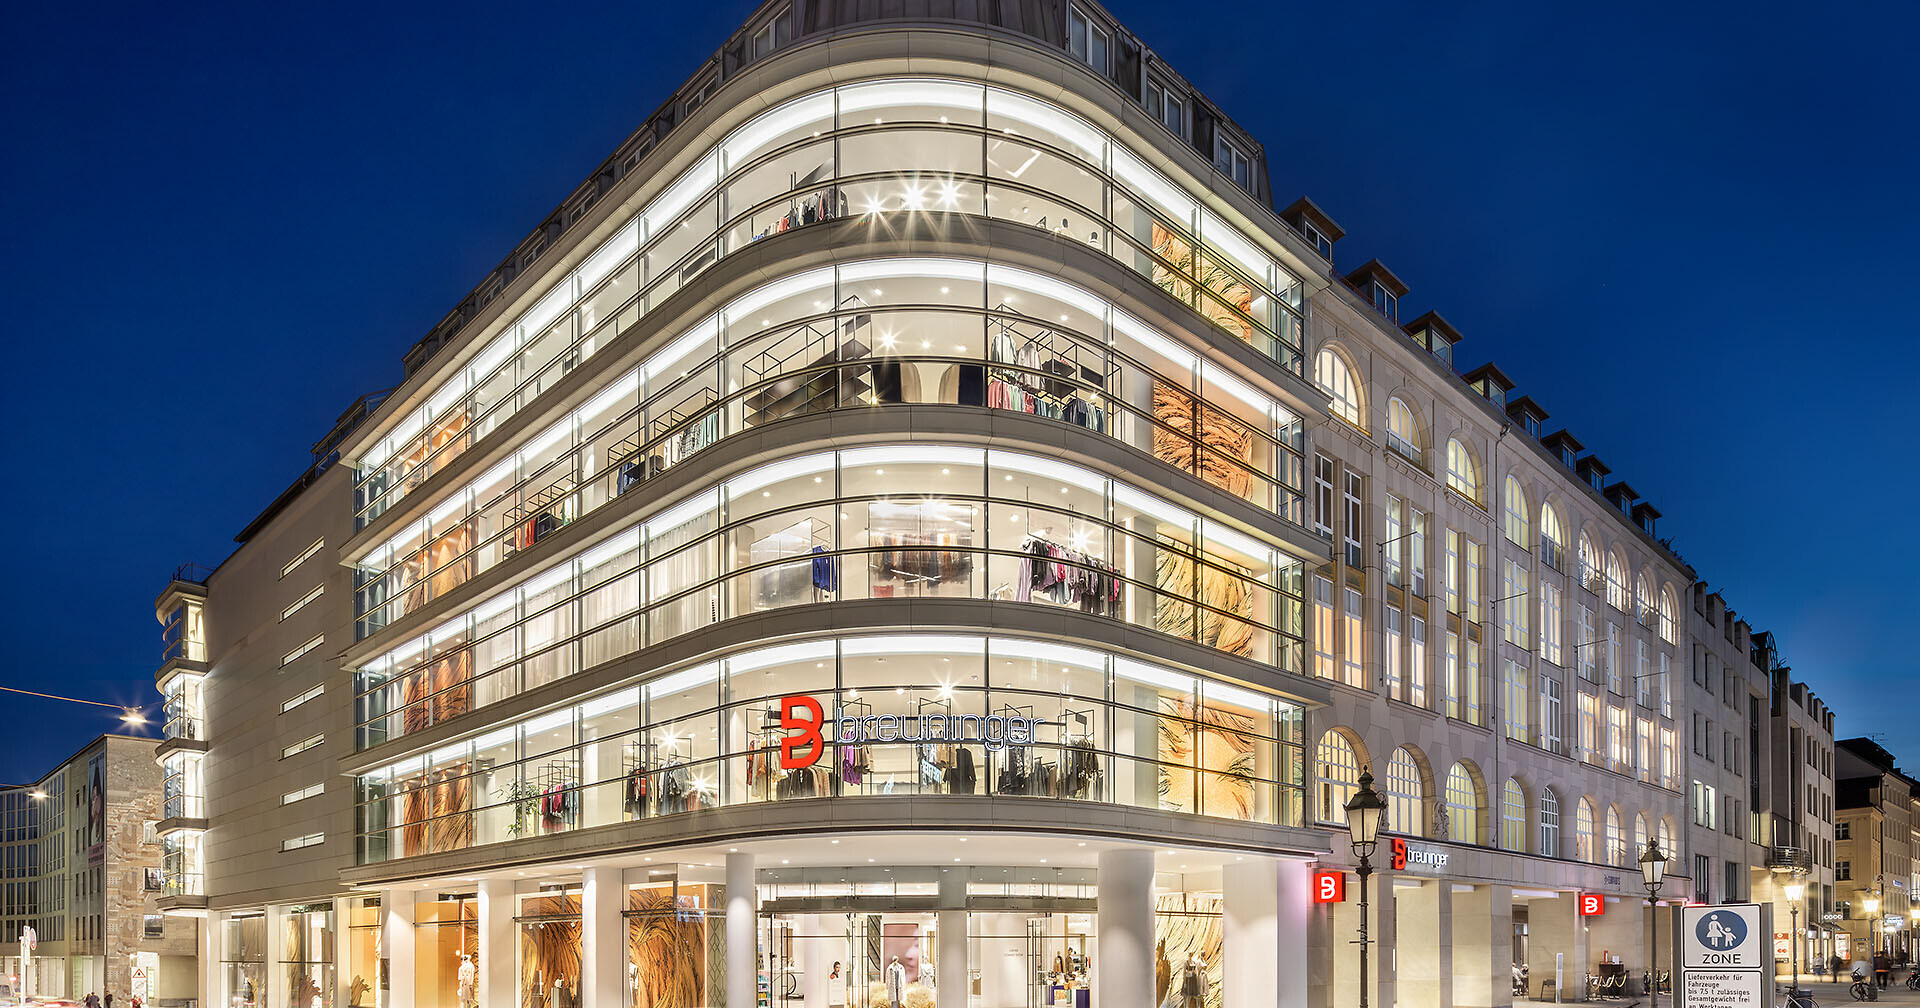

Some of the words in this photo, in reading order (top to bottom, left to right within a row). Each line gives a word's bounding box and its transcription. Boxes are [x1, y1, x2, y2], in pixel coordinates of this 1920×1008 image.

[836, 706, 1044, 751] breuninger
[1702, 954, 1741, 964] ZONE
[1688, 980, 1720, 989] Fahrzeuge
[1716, 989, 1750, 997] zulässiges
[1688, 994, 1736, 1003] Gesamtgewicht
